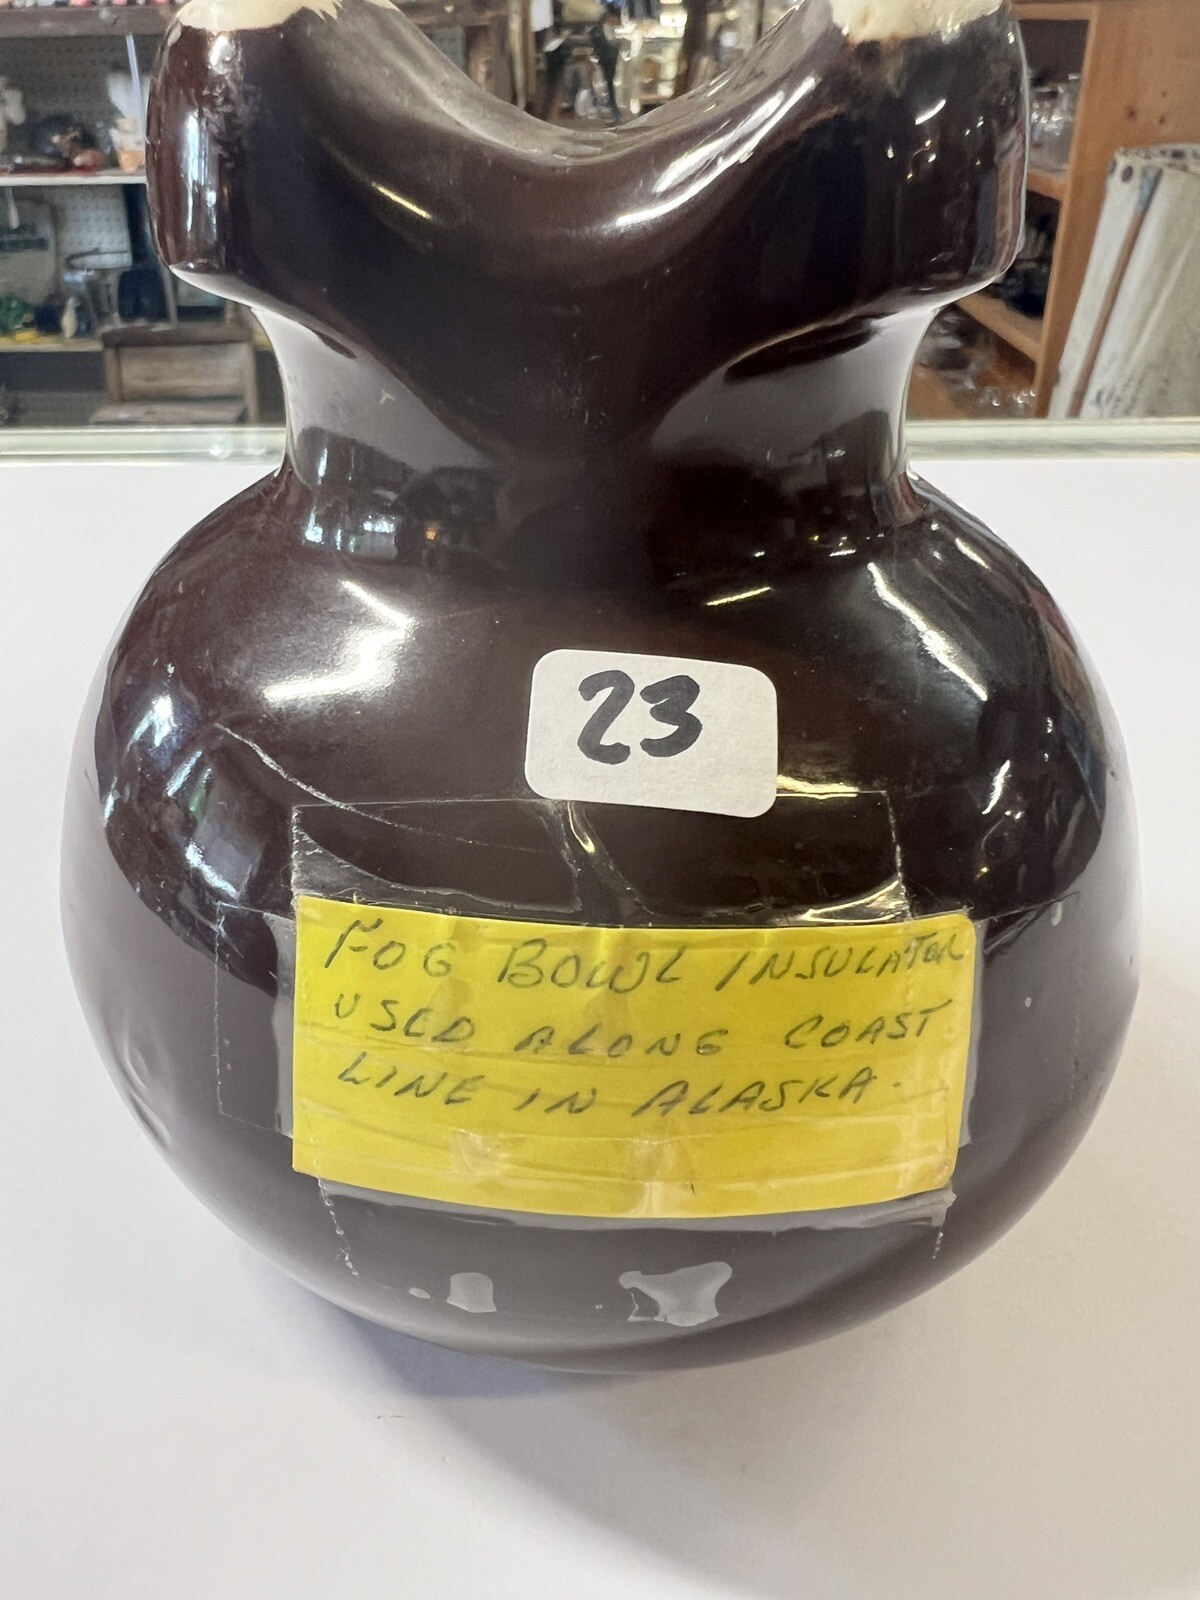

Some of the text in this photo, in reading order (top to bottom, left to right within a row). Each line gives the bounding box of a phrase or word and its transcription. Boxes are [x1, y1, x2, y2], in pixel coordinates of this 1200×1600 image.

[577, 669, 703, 765] 23
[325, 918, 457, 978] FOG
[497, 938, 688, 994] BOWL
[514, 1022, 728, 1058] ALONG
[784, 998, 953, 1050] COAST
[337, 1051, 485, 1105] LINE
[514, 1087, 598, 1115] IN
